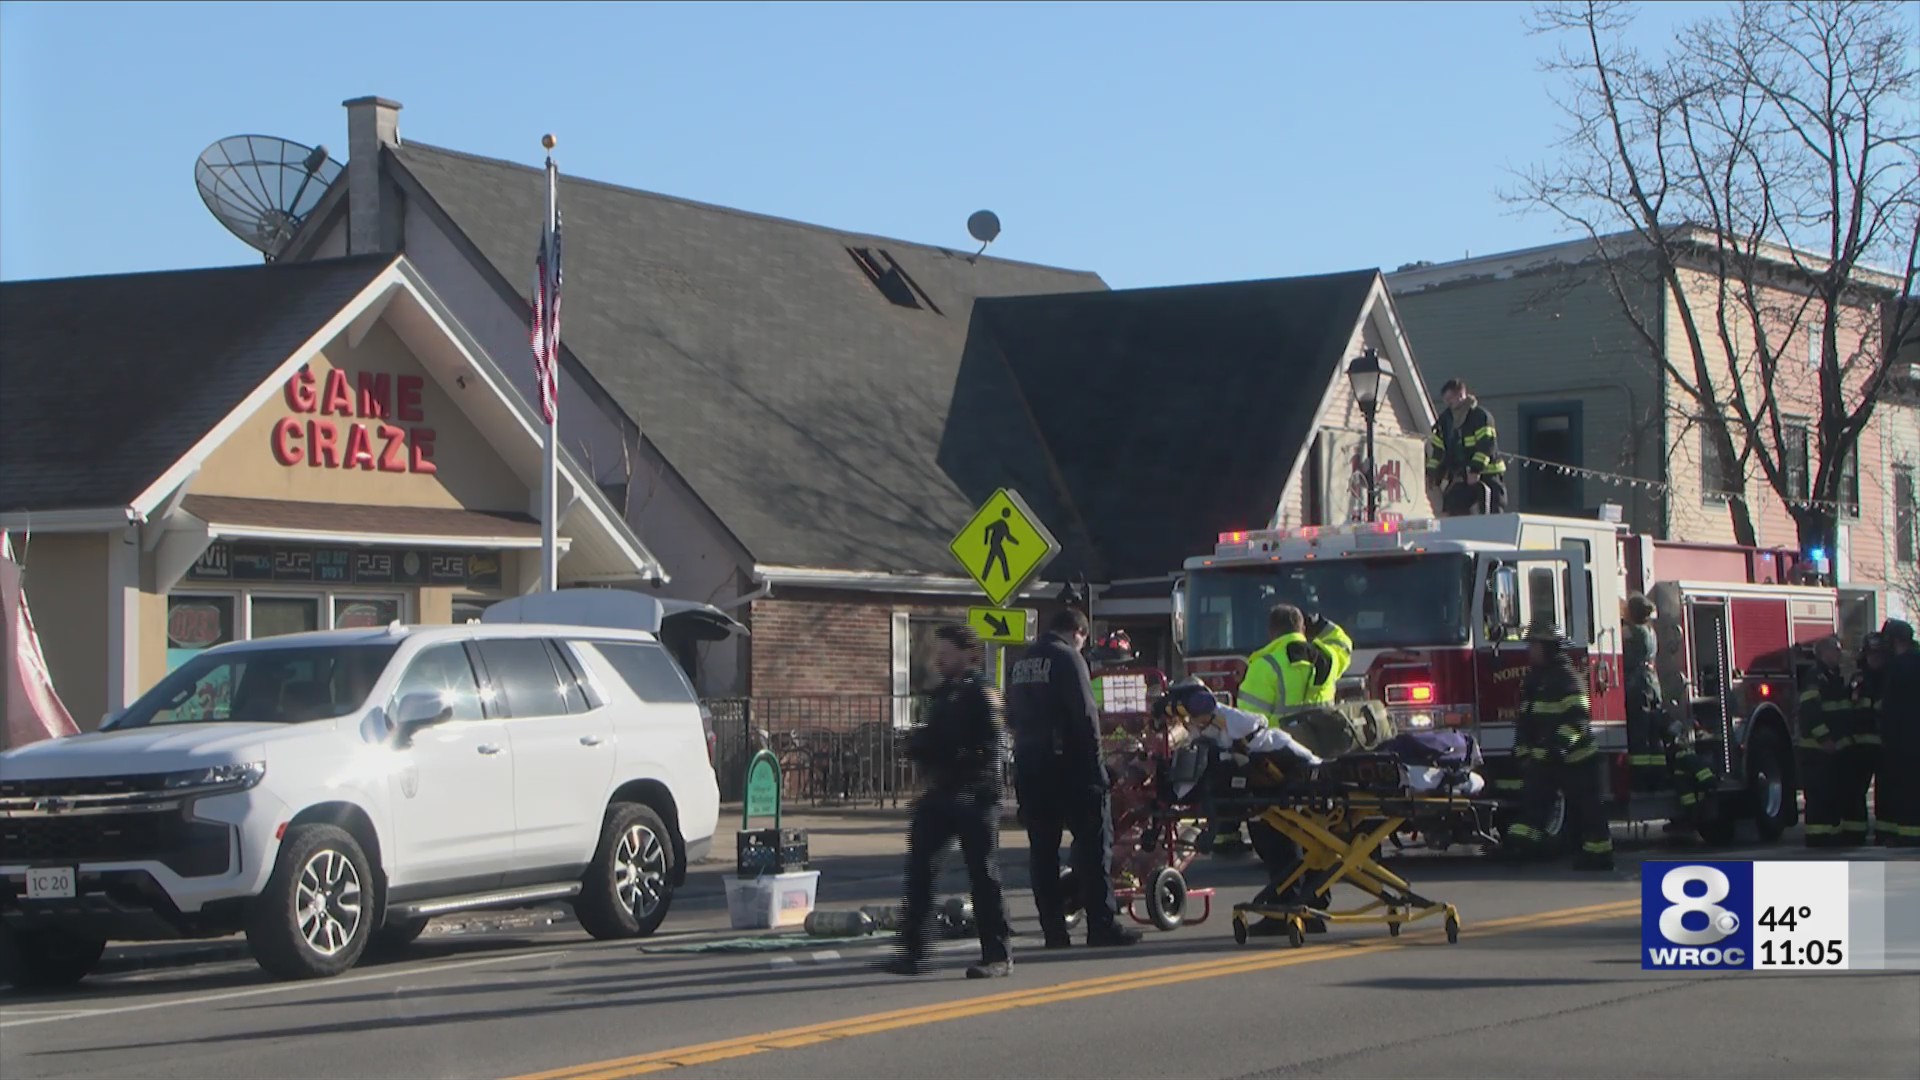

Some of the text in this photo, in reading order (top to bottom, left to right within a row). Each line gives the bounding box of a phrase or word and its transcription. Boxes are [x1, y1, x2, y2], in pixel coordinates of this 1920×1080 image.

[284, 363, 424, 421] GAME
[271, 417, 437, 474] CRAZE
[198, 545, 227, 567] Wii
[275, 552, 311, 567] PSP
[357, 554, 391, 570] PS3
[432, 557, 463, 571] PS2
[1012, 657, 1052, 677] PENFIELD
[51, 876, 69, 890] 20
